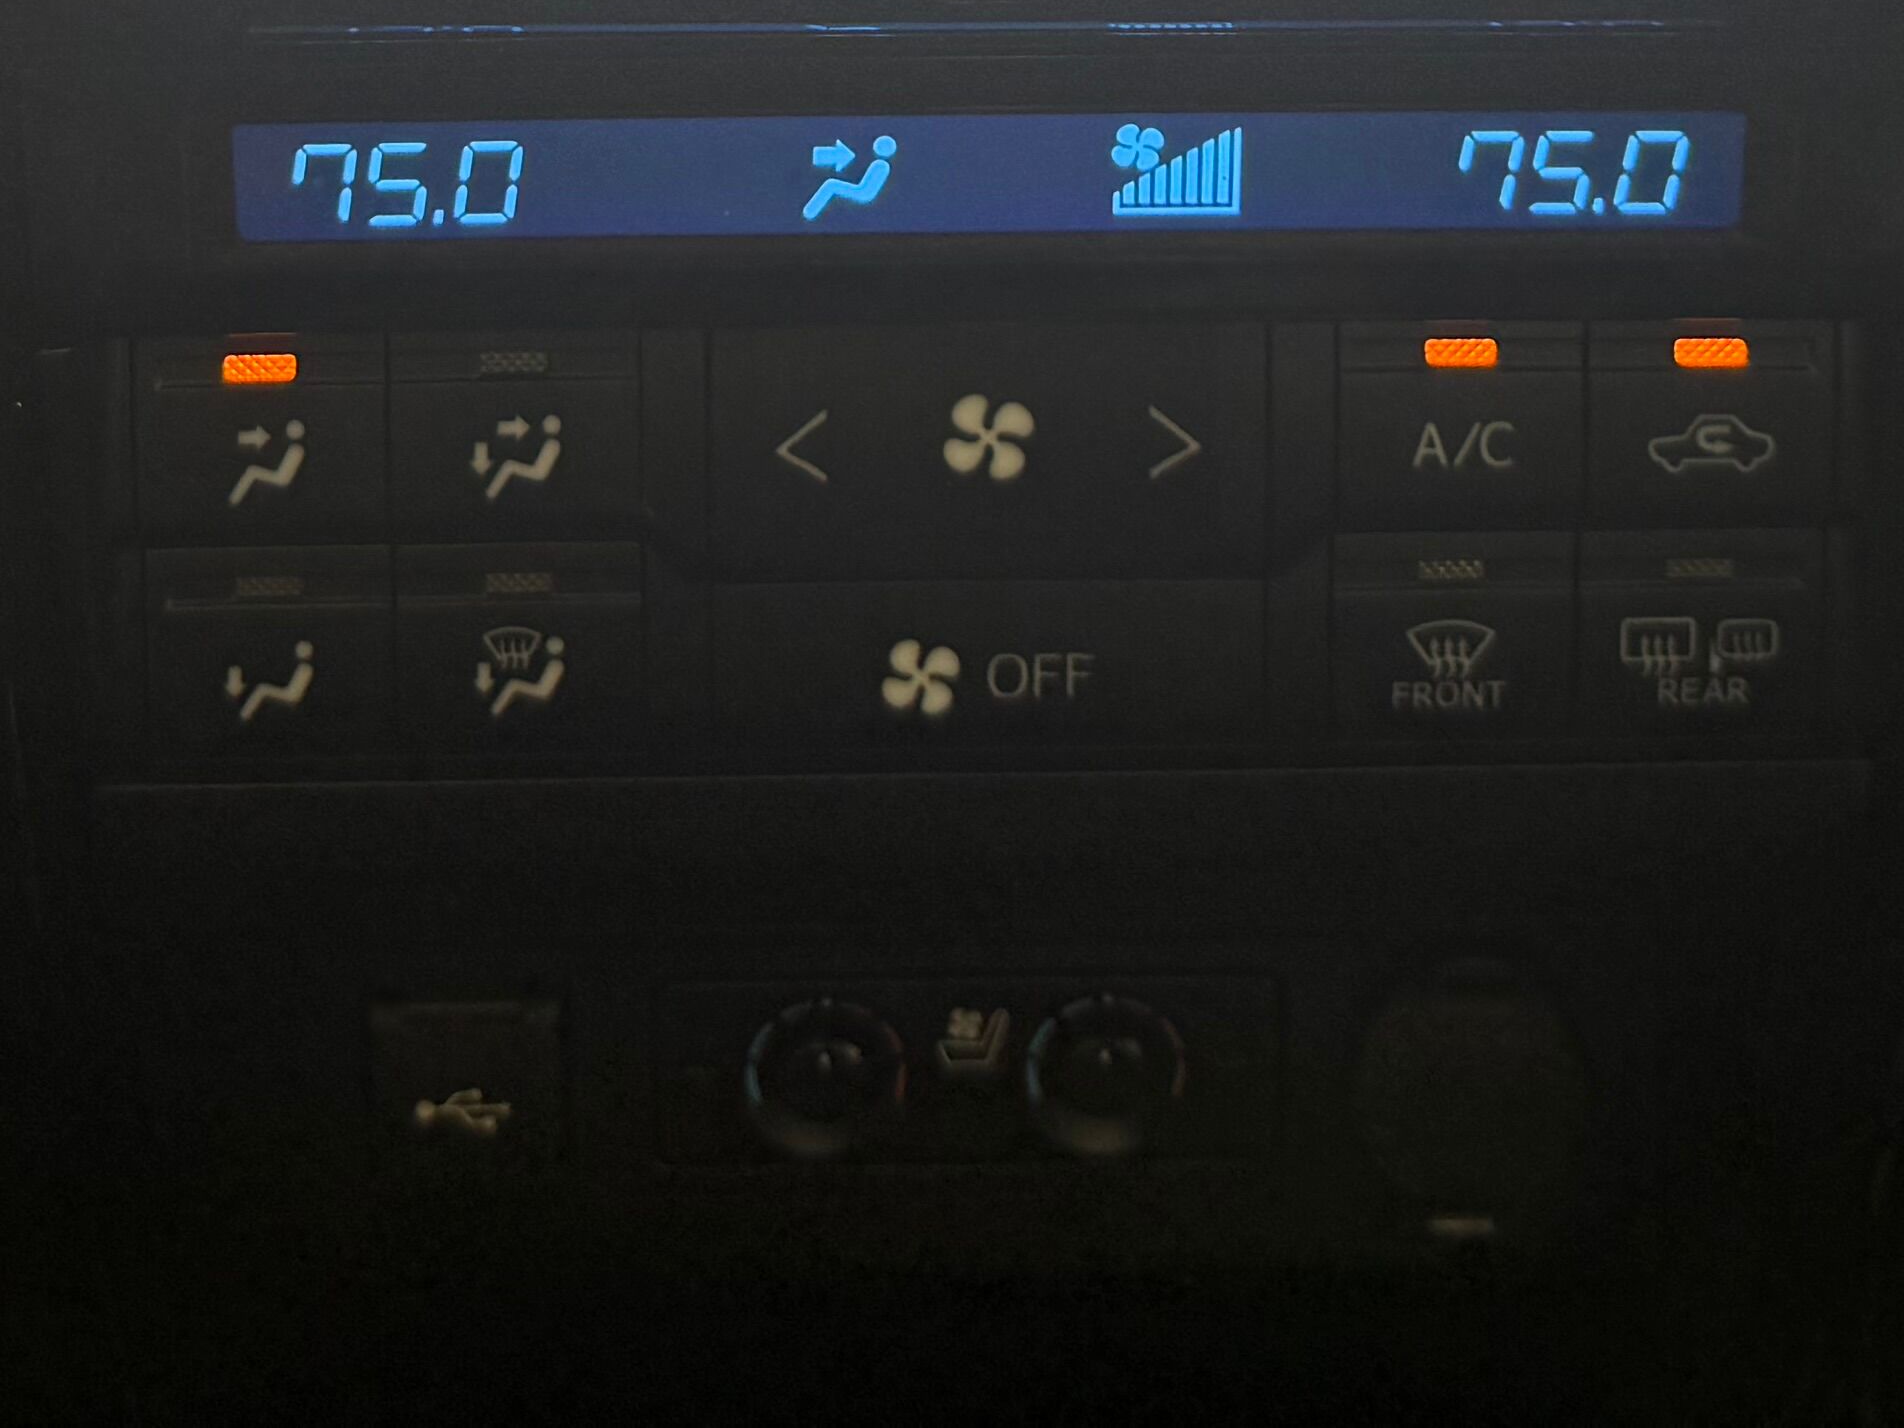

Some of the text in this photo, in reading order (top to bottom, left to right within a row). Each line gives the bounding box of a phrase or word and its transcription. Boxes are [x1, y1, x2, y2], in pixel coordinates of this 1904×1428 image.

[291, 139, 524, 227] 75.0
[1457, 129, 1691, 215] 75.0
[1412, 422, 1516, 468] A/C
[986, 652, 1093, 699] OFF
[1391, 679, 1507, 708] FRONT
[1657, 677, 1750, 704] REAR
